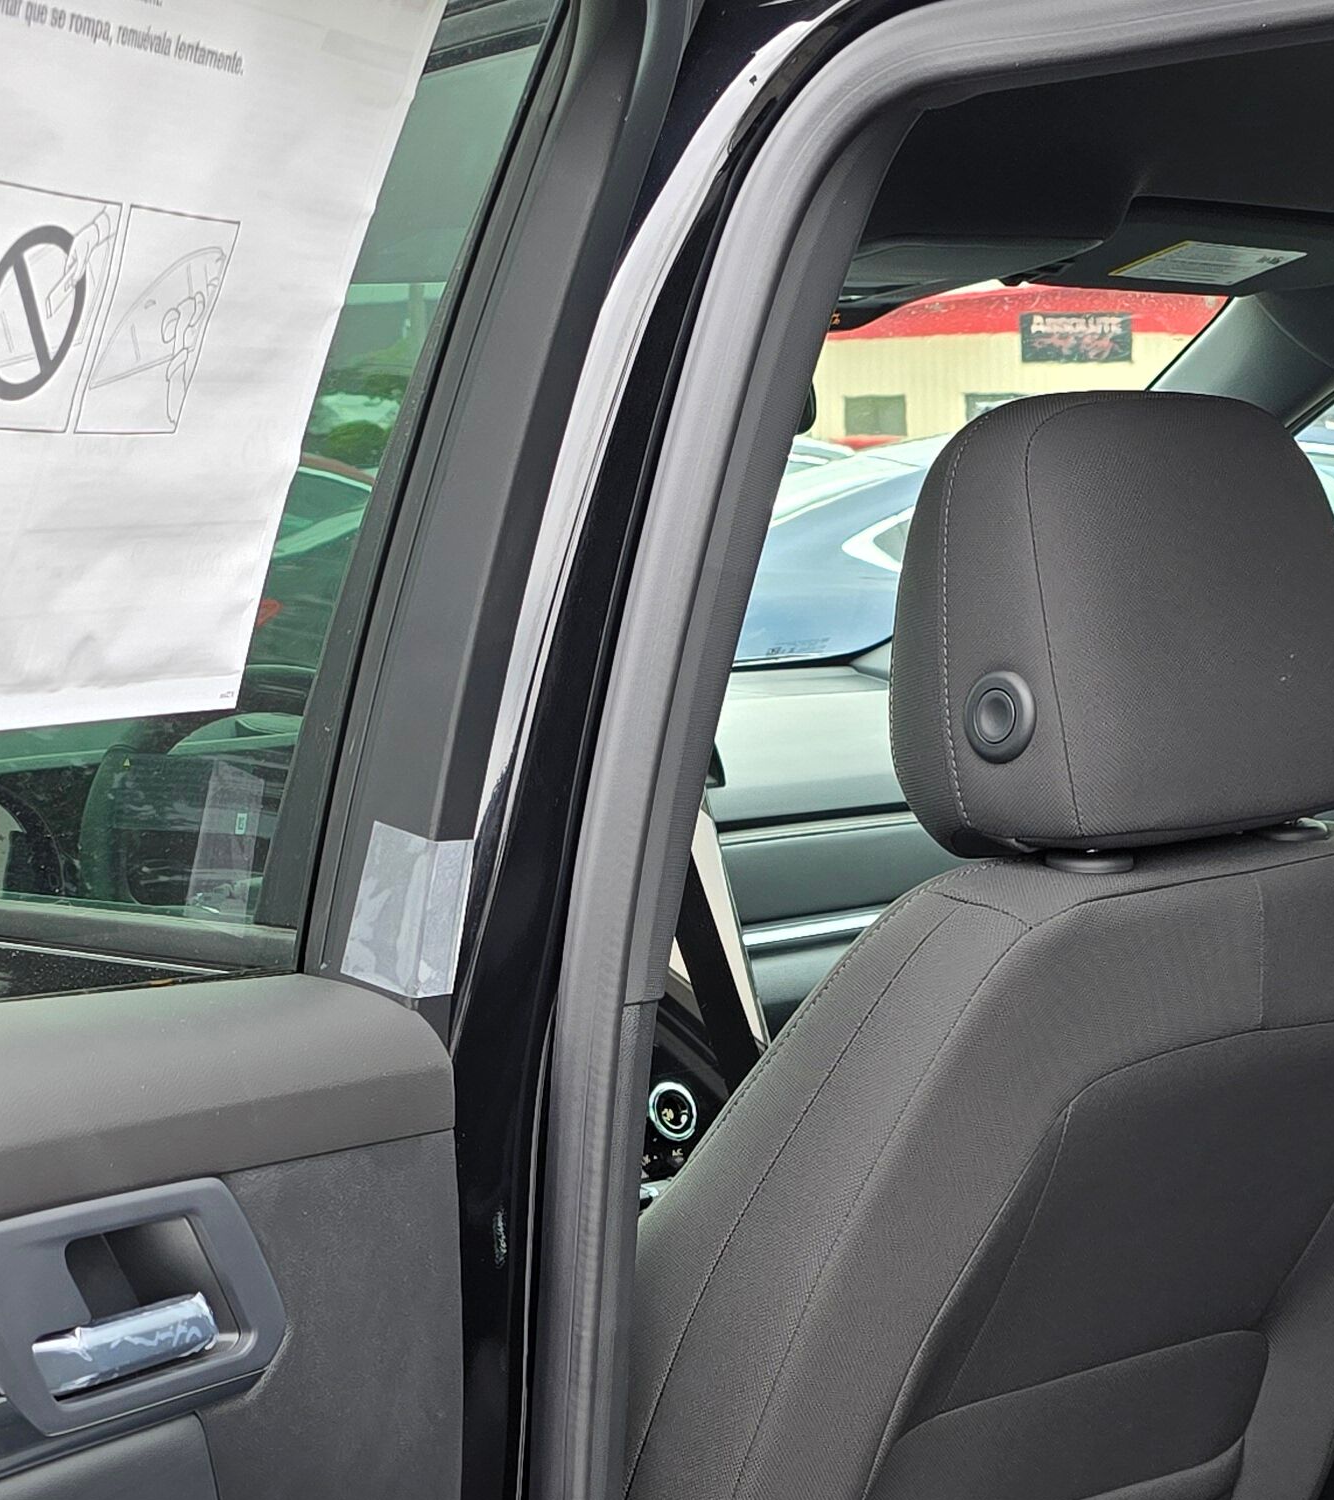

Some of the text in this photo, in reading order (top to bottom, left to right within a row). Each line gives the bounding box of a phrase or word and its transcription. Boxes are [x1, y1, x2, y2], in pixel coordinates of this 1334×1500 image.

[24, 1, 48, 27] que
[50, 7, 67, 29] se
[68, 12, 113, 46] rompa,
[116, 25, 173, 57] remuévala
[174, 34, 244, 76] lentamente.
